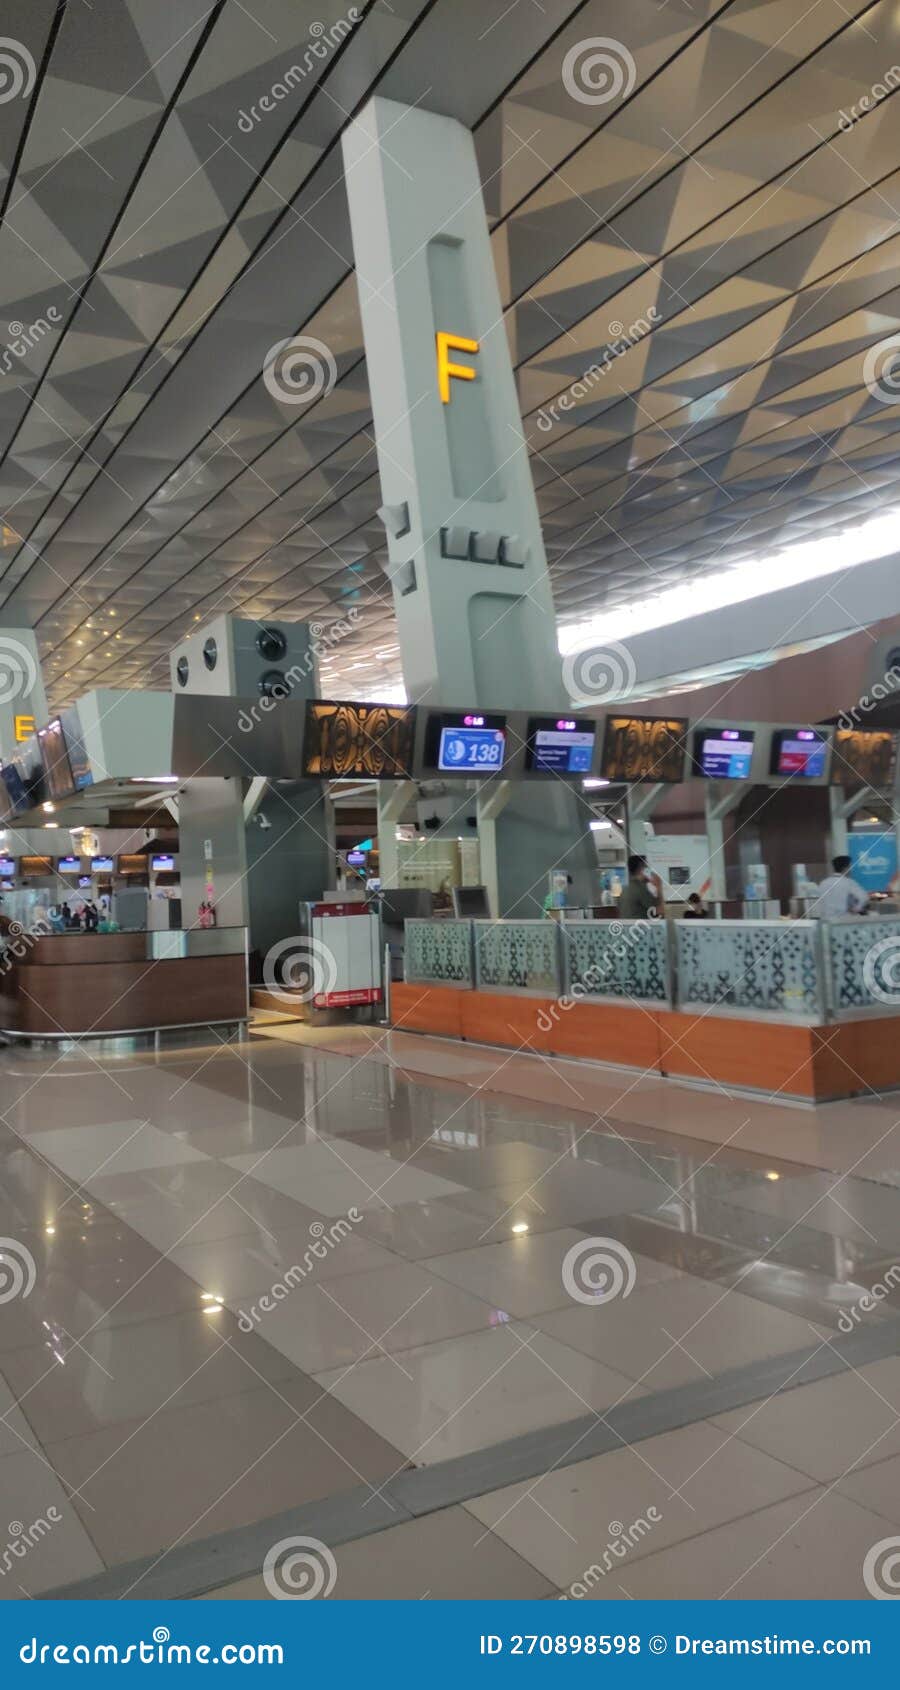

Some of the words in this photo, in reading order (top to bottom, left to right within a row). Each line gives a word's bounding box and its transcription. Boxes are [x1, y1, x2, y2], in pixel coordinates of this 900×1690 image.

[435, 331, 480, 404] F
[14, 714, 36, 743] E
[468, 743, 500, 762] 138
